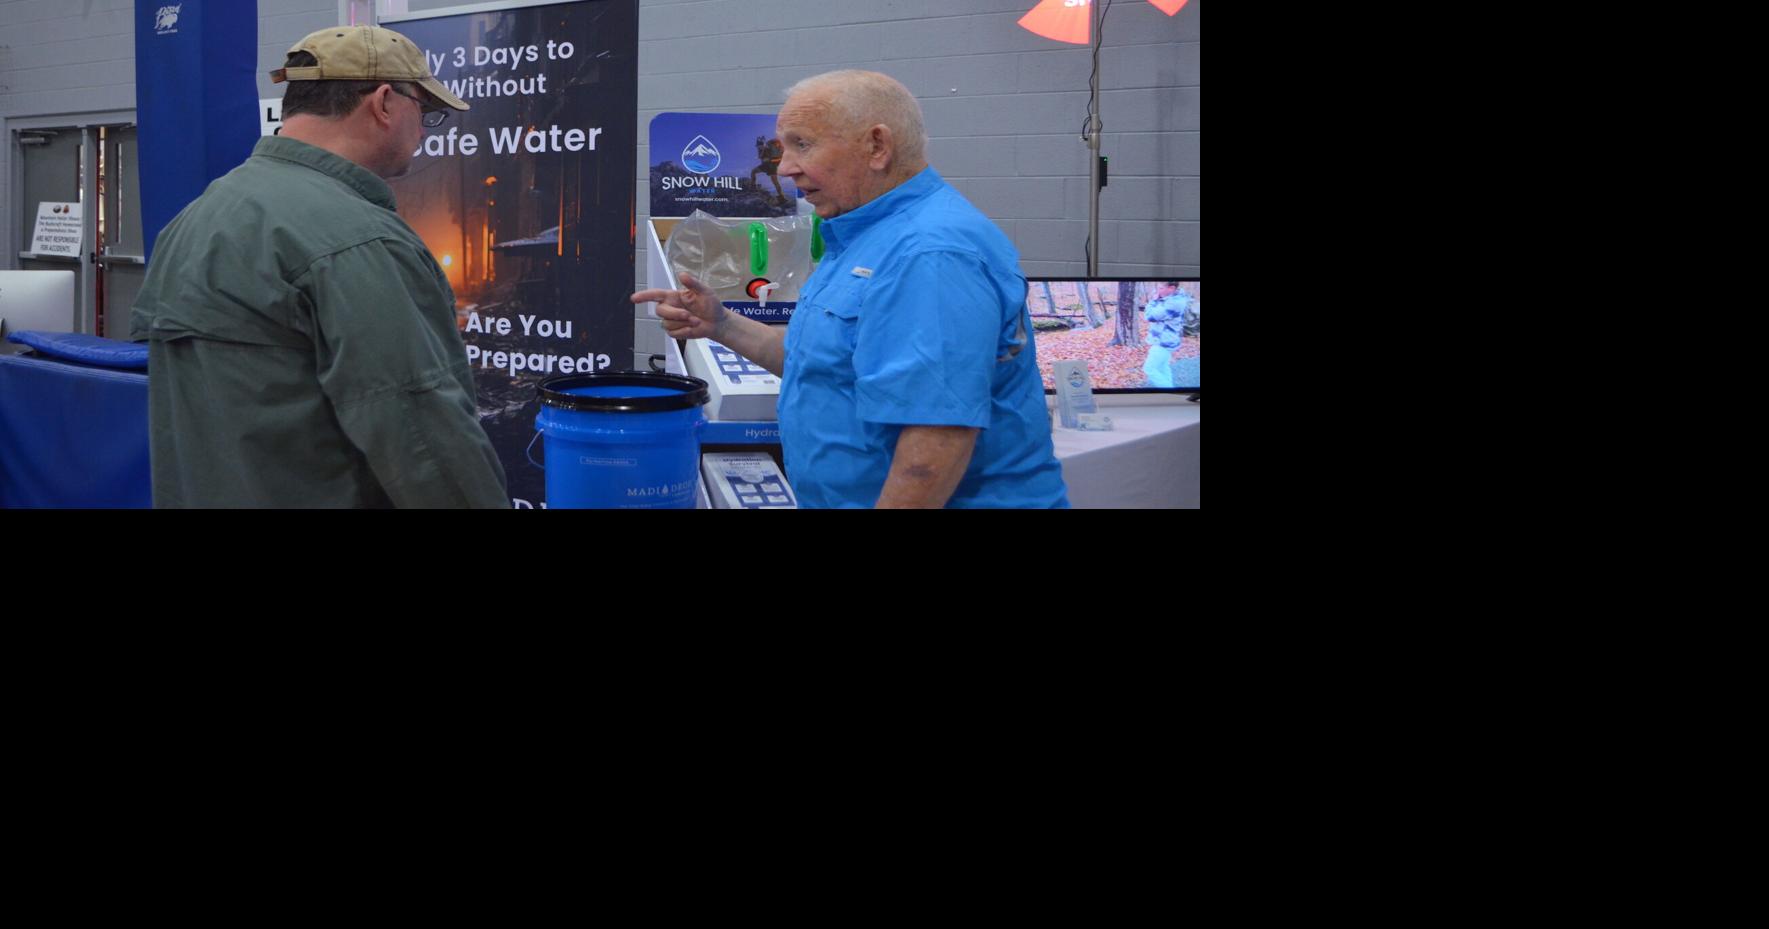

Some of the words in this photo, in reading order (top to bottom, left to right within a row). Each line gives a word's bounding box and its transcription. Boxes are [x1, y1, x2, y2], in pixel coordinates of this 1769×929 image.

[452, 47, 466, 68] 3
[474, 44, 539, 70] Days
[546, 40, 575, 60] to
[443, 73, 547, 99] Without
[412, 127, 479, 157] afe
[488, 125, 602, 155] Water
[661, 176, 710, 191] SNOW
[714, 176, 743, 191] HILL
[743, 307, 780, 316] Water.
[465, 311, 512, 336] Are
[518, 314, 573, 339] You
[465, 344, 612, 377] Prepared?
[745, 428, 781, 439] Hydra
[626, 486, 660, 497] MADI
